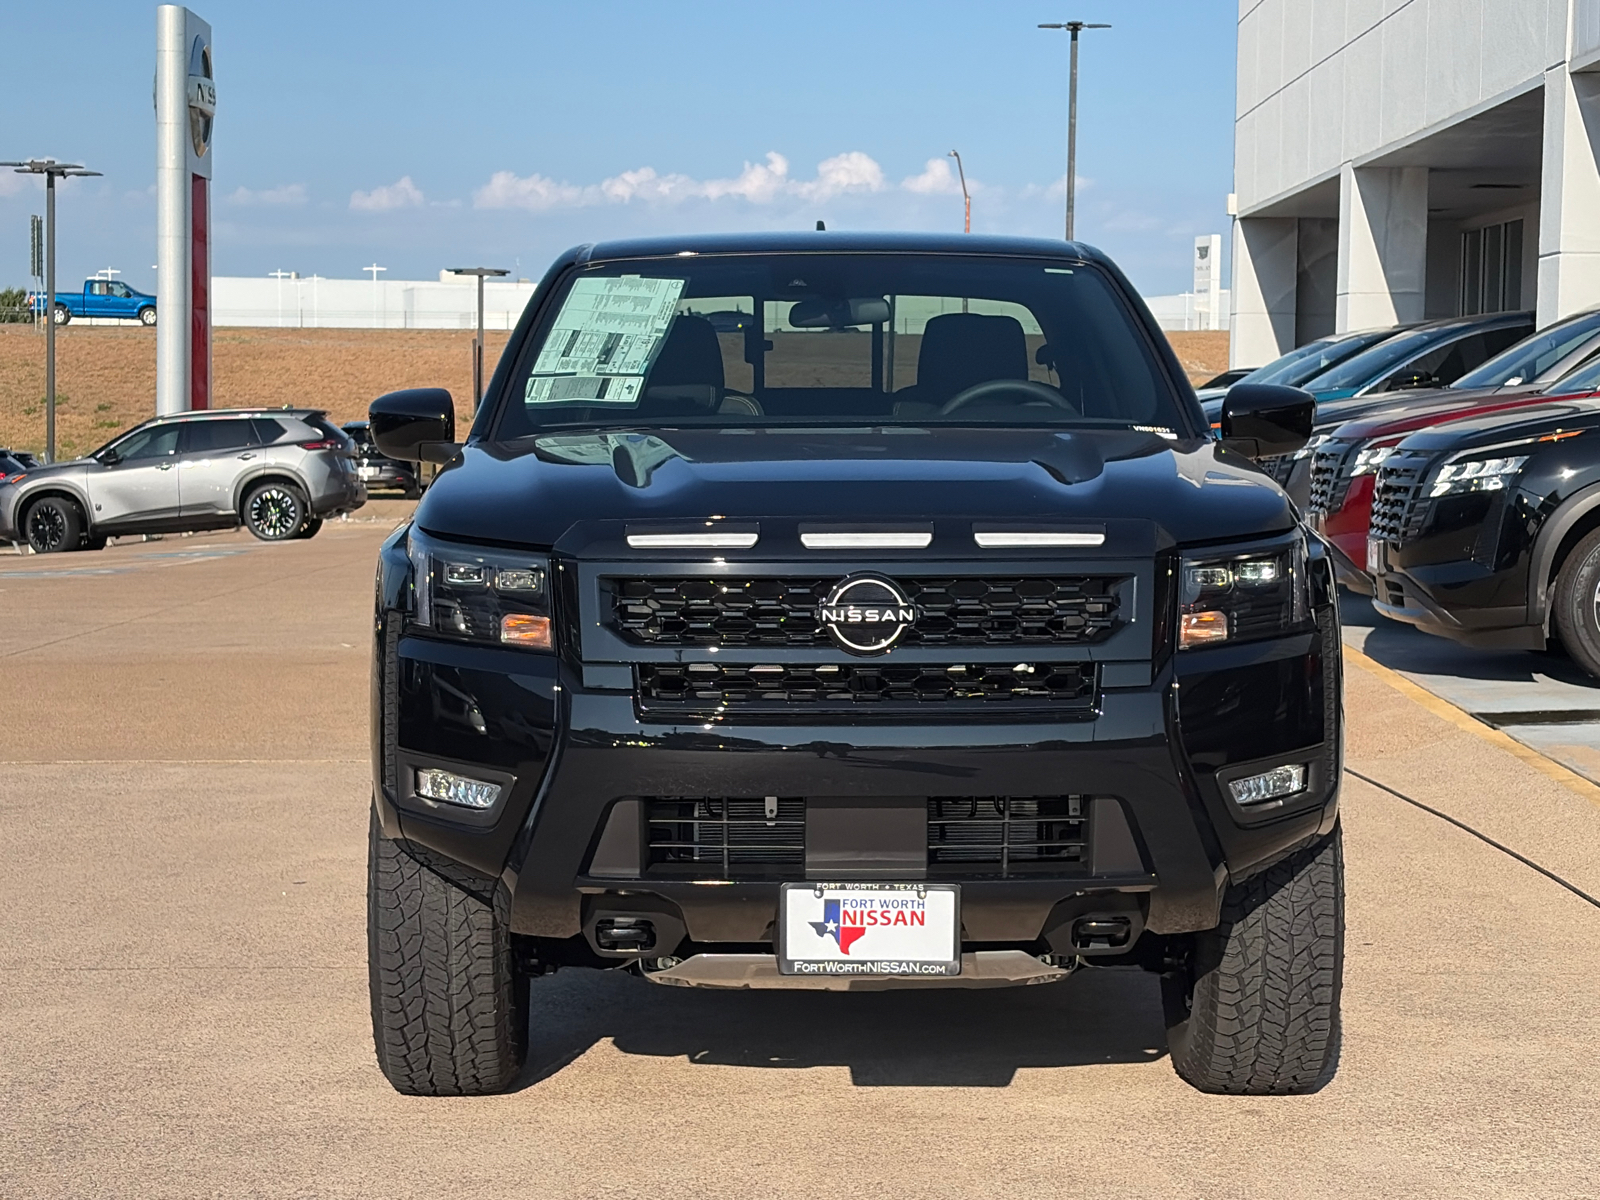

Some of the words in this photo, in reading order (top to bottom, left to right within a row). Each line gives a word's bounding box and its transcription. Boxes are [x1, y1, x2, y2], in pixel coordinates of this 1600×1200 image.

[821, 609, 914, 622] NISSAN
[842, 899, 875, 909] FORT
[878, 899, 925, 910] WORTH
[842, 910, 925, 926] NISSAN
